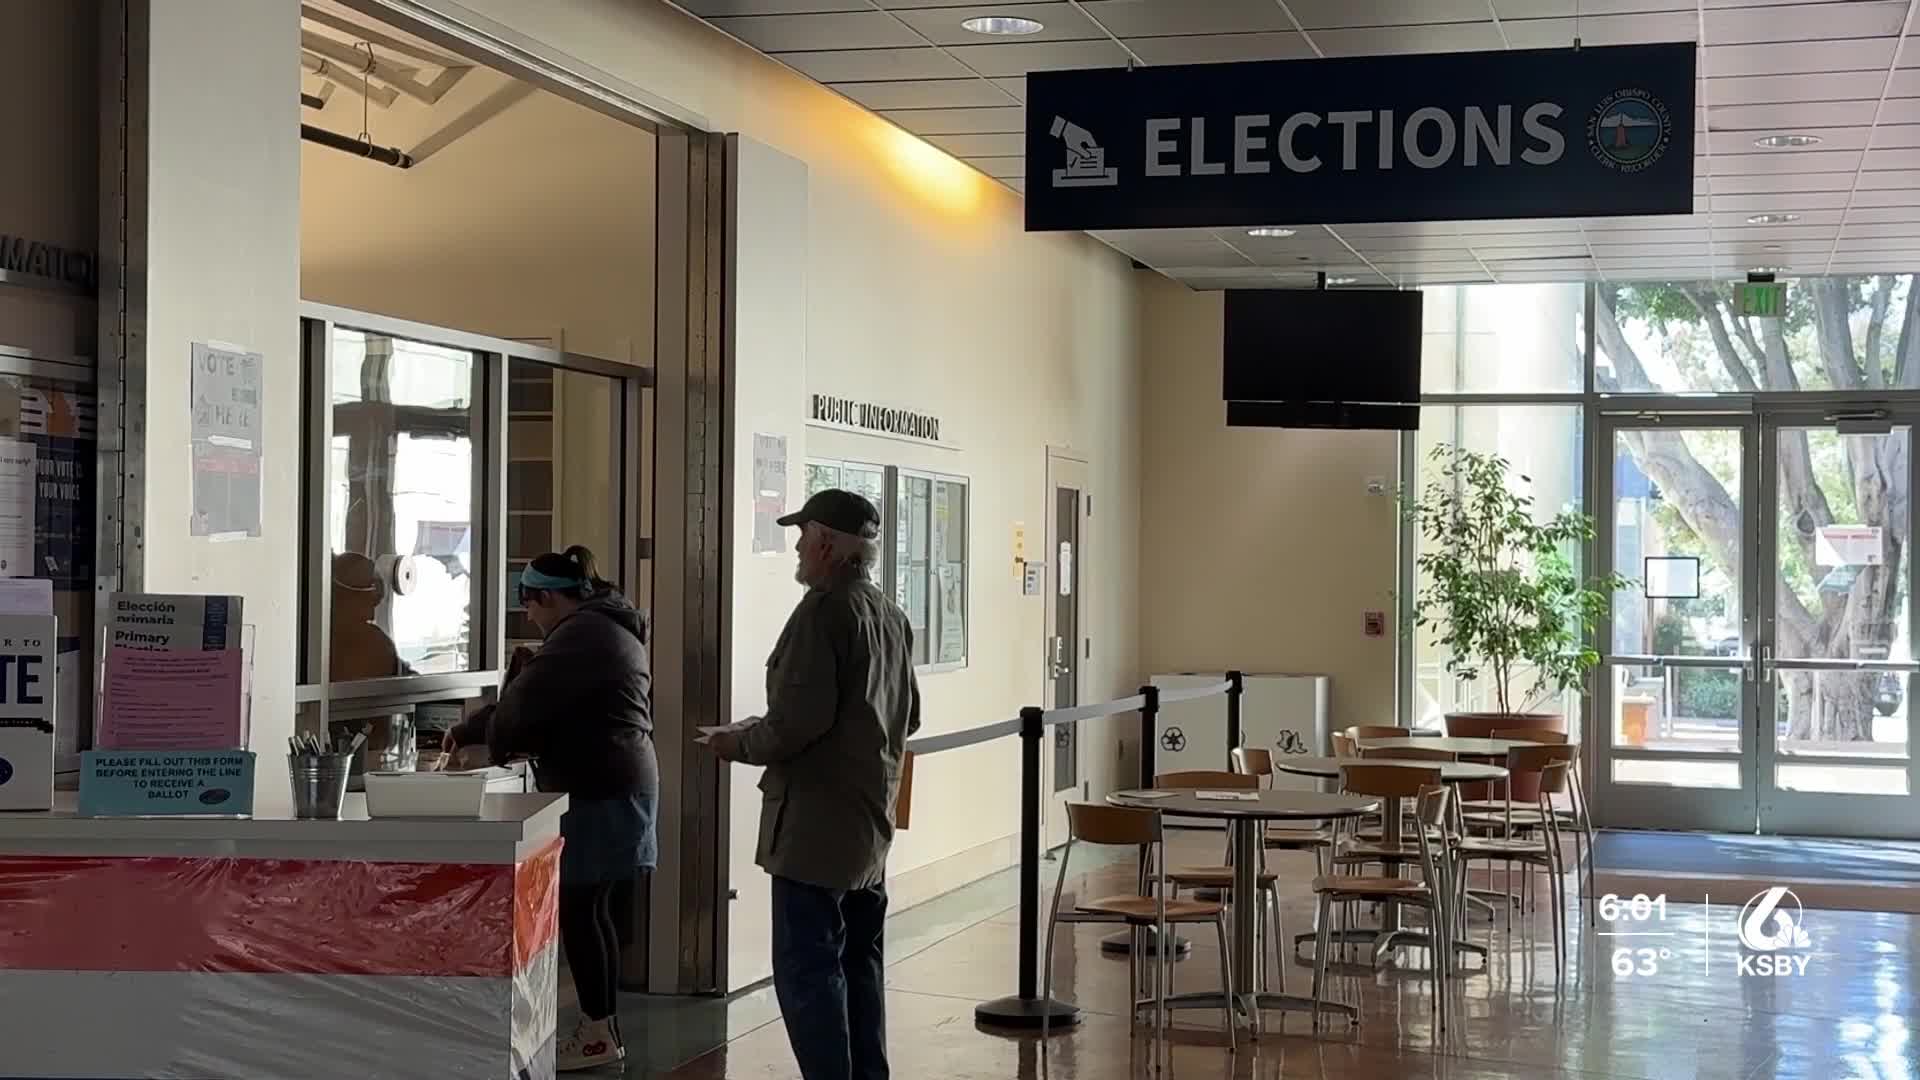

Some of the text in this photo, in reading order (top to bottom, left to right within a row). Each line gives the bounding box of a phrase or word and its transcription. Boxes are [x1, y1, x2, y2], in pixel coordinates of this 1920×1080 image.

[1144, 102, 1567, 177] ELECTIONS
[813, 394, 940, 440] PUBLIC INFORMATION
[117, 600, 176, 613] Elección
[23, 638, 41, 647] TO
[115, 630, 171, 646] Primary
[96, 757, 243, 767] PLEASE FILL OUT THIS FORM
[96, 767, 242, 778] BEFORE ENTERING THE LINE
[133, 779, 205, 788] TO RECEIVE A
[148, 790, 189, 799] BALLOT
